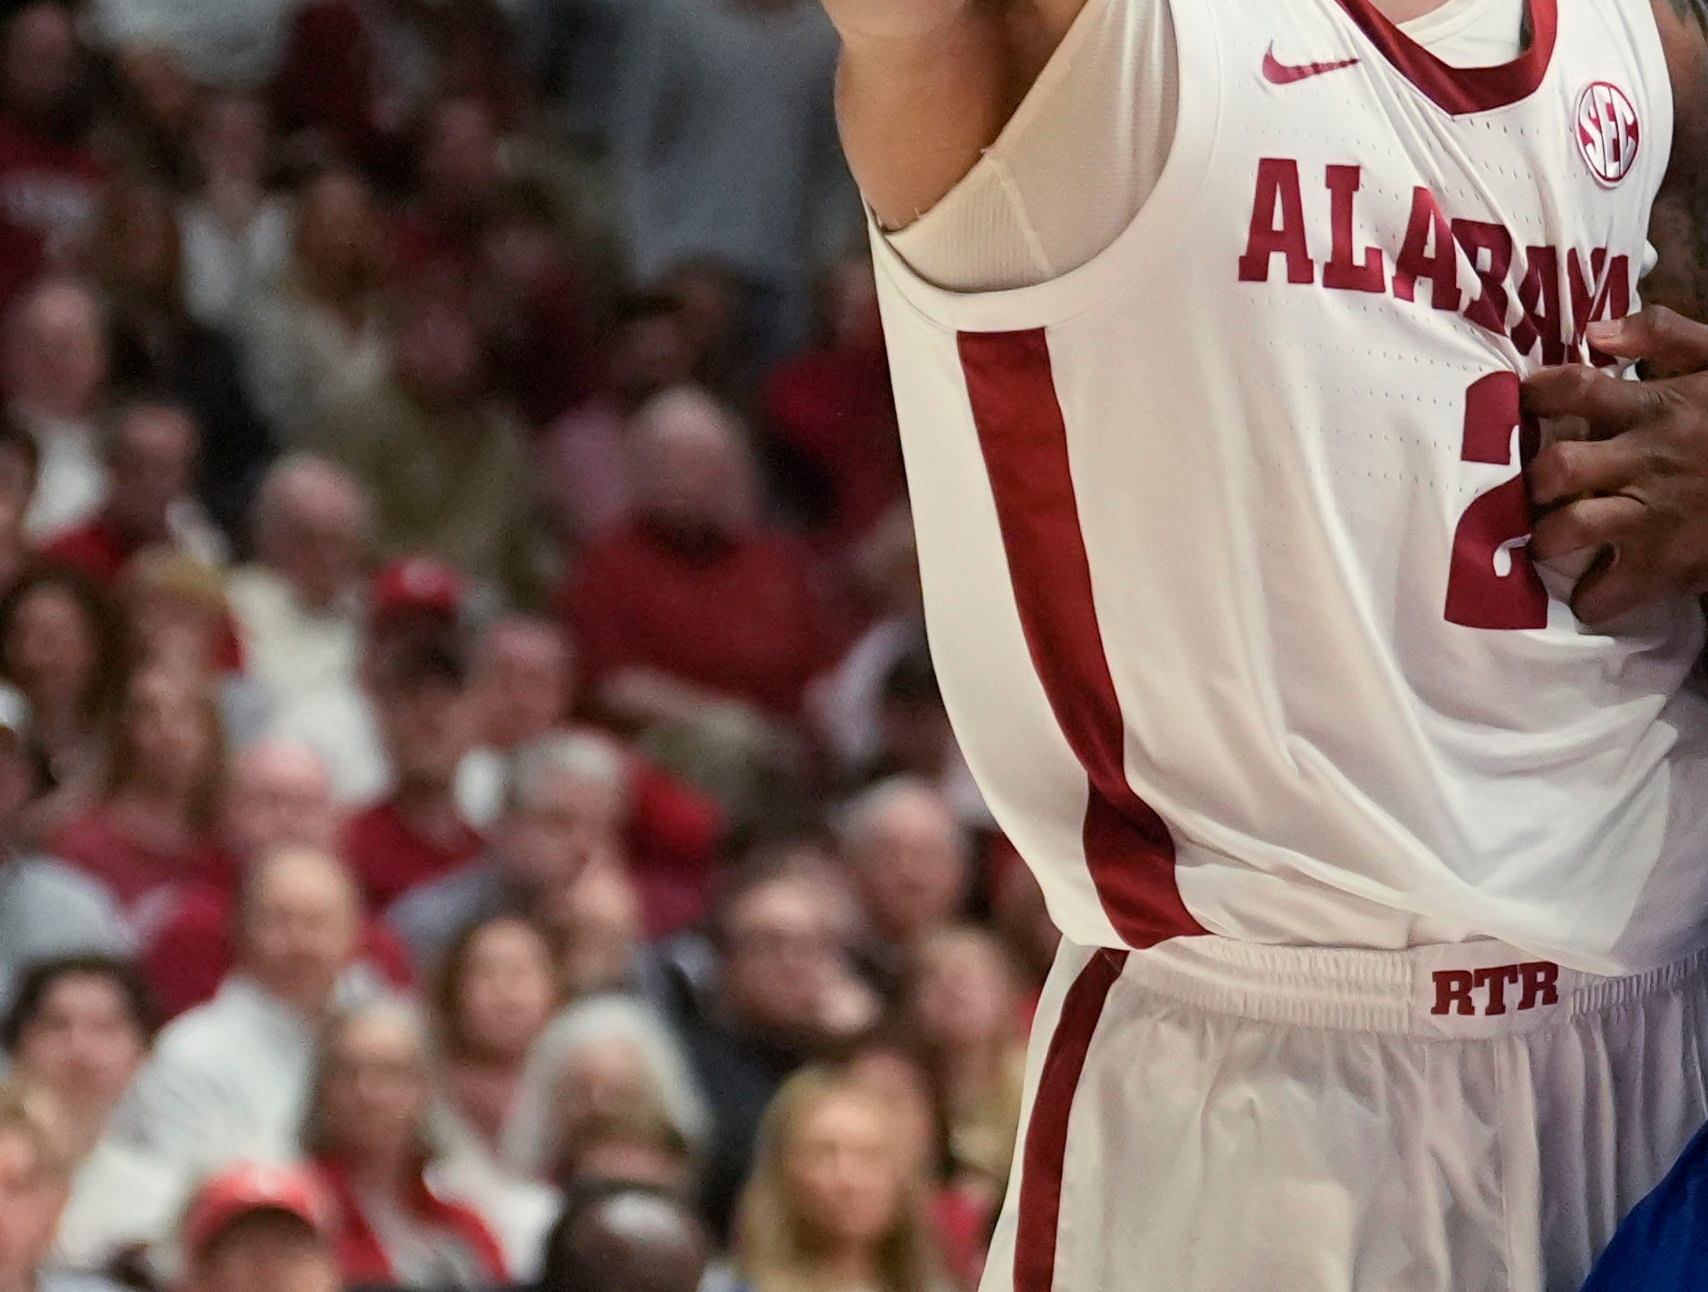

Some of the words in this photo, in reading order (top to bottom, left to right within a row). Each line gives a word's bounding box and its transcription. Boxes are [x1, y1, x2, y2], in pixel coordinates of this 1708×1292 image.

[1578, 82, 1639, 180] SEC
[1444, 370, 1549, 631] 2
[1430, 960, 1559, 1016] RTR
